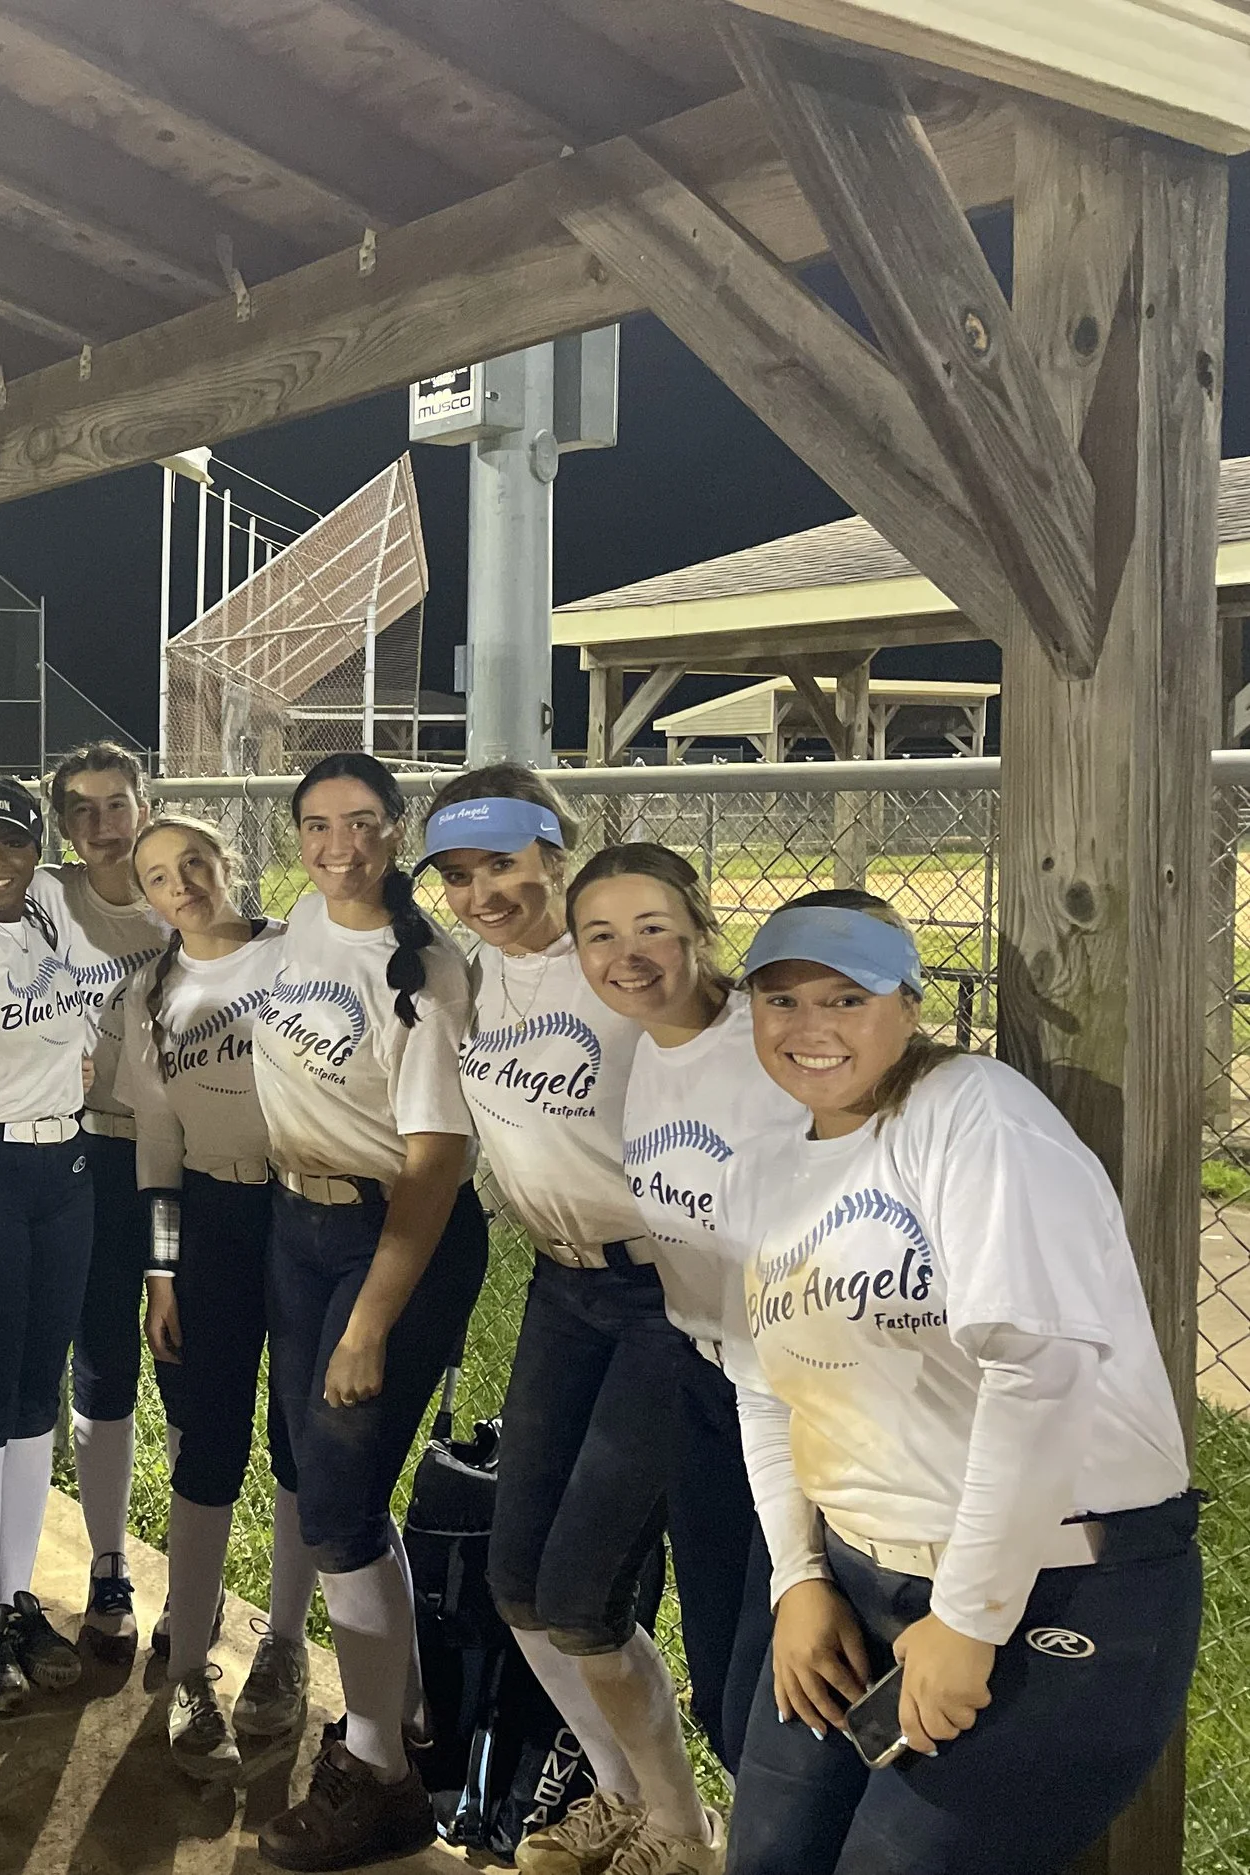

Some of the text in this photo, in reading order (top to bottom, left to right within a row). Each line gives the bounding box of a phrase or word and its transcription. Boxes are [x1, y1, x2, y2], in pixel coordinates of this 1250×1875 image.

[439, 804, 490, 826] Blue Angels
[0, 998, 54, 1030] Blue
[56, 991, 84, 1017] Ang
[276, 1013, 354, 1067] Angels
[165, 1044, 209, 1079] Blue
[303, 1059, 347, 1086] Fastpitch
[495, 1058, 596, 1103] Angels
[542, 1102, 596, 1119] Fastpitch
[650, 1171, 713, 1218] Ange
[748, 1248, 934, 1338] Blue Angels
